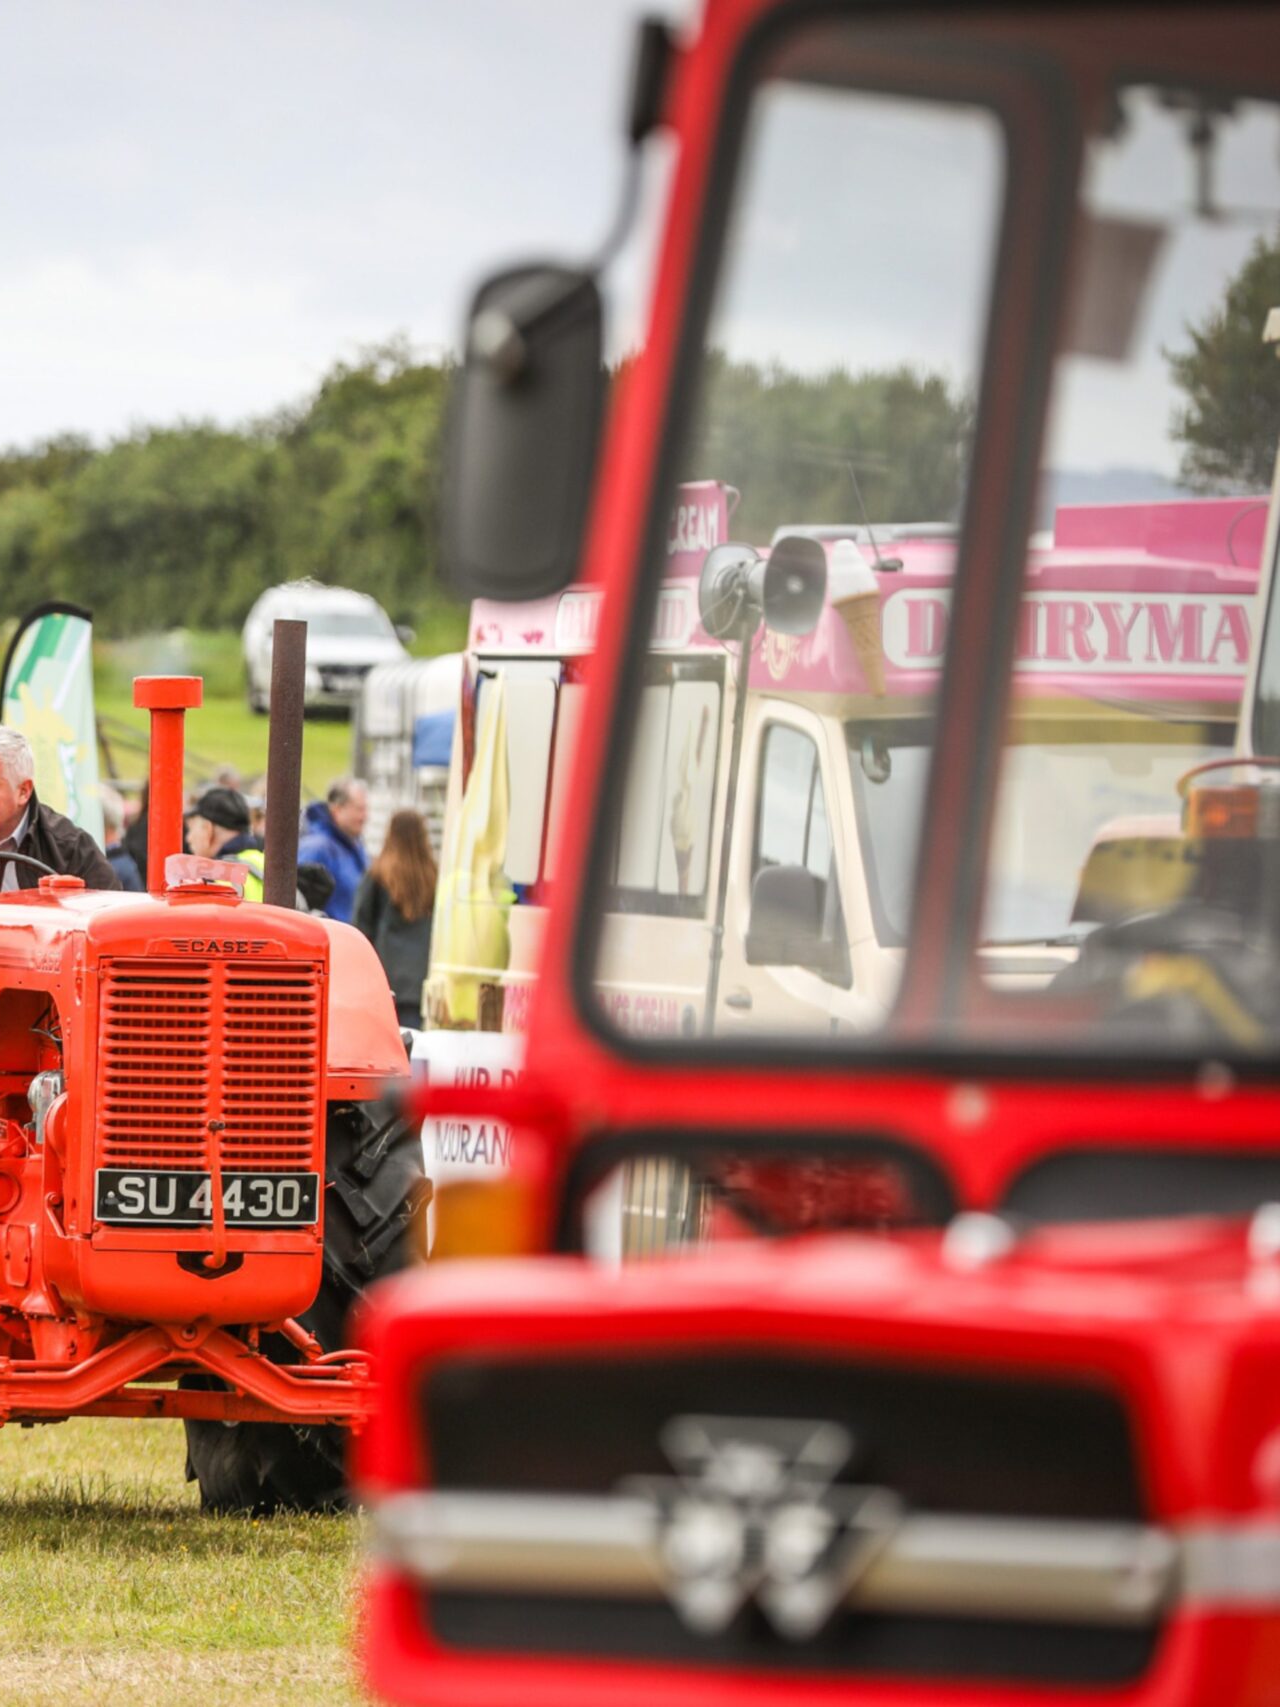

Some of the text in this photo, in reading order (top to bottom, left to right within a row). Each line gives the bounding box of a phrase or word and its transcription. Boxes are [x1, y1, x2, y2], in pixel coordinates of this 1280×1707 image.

[904, 598, 1251, 665] DIRYMA
[191, 940, 249, 953] CASE
[117, 1176, 301, 1218] SU 4430
